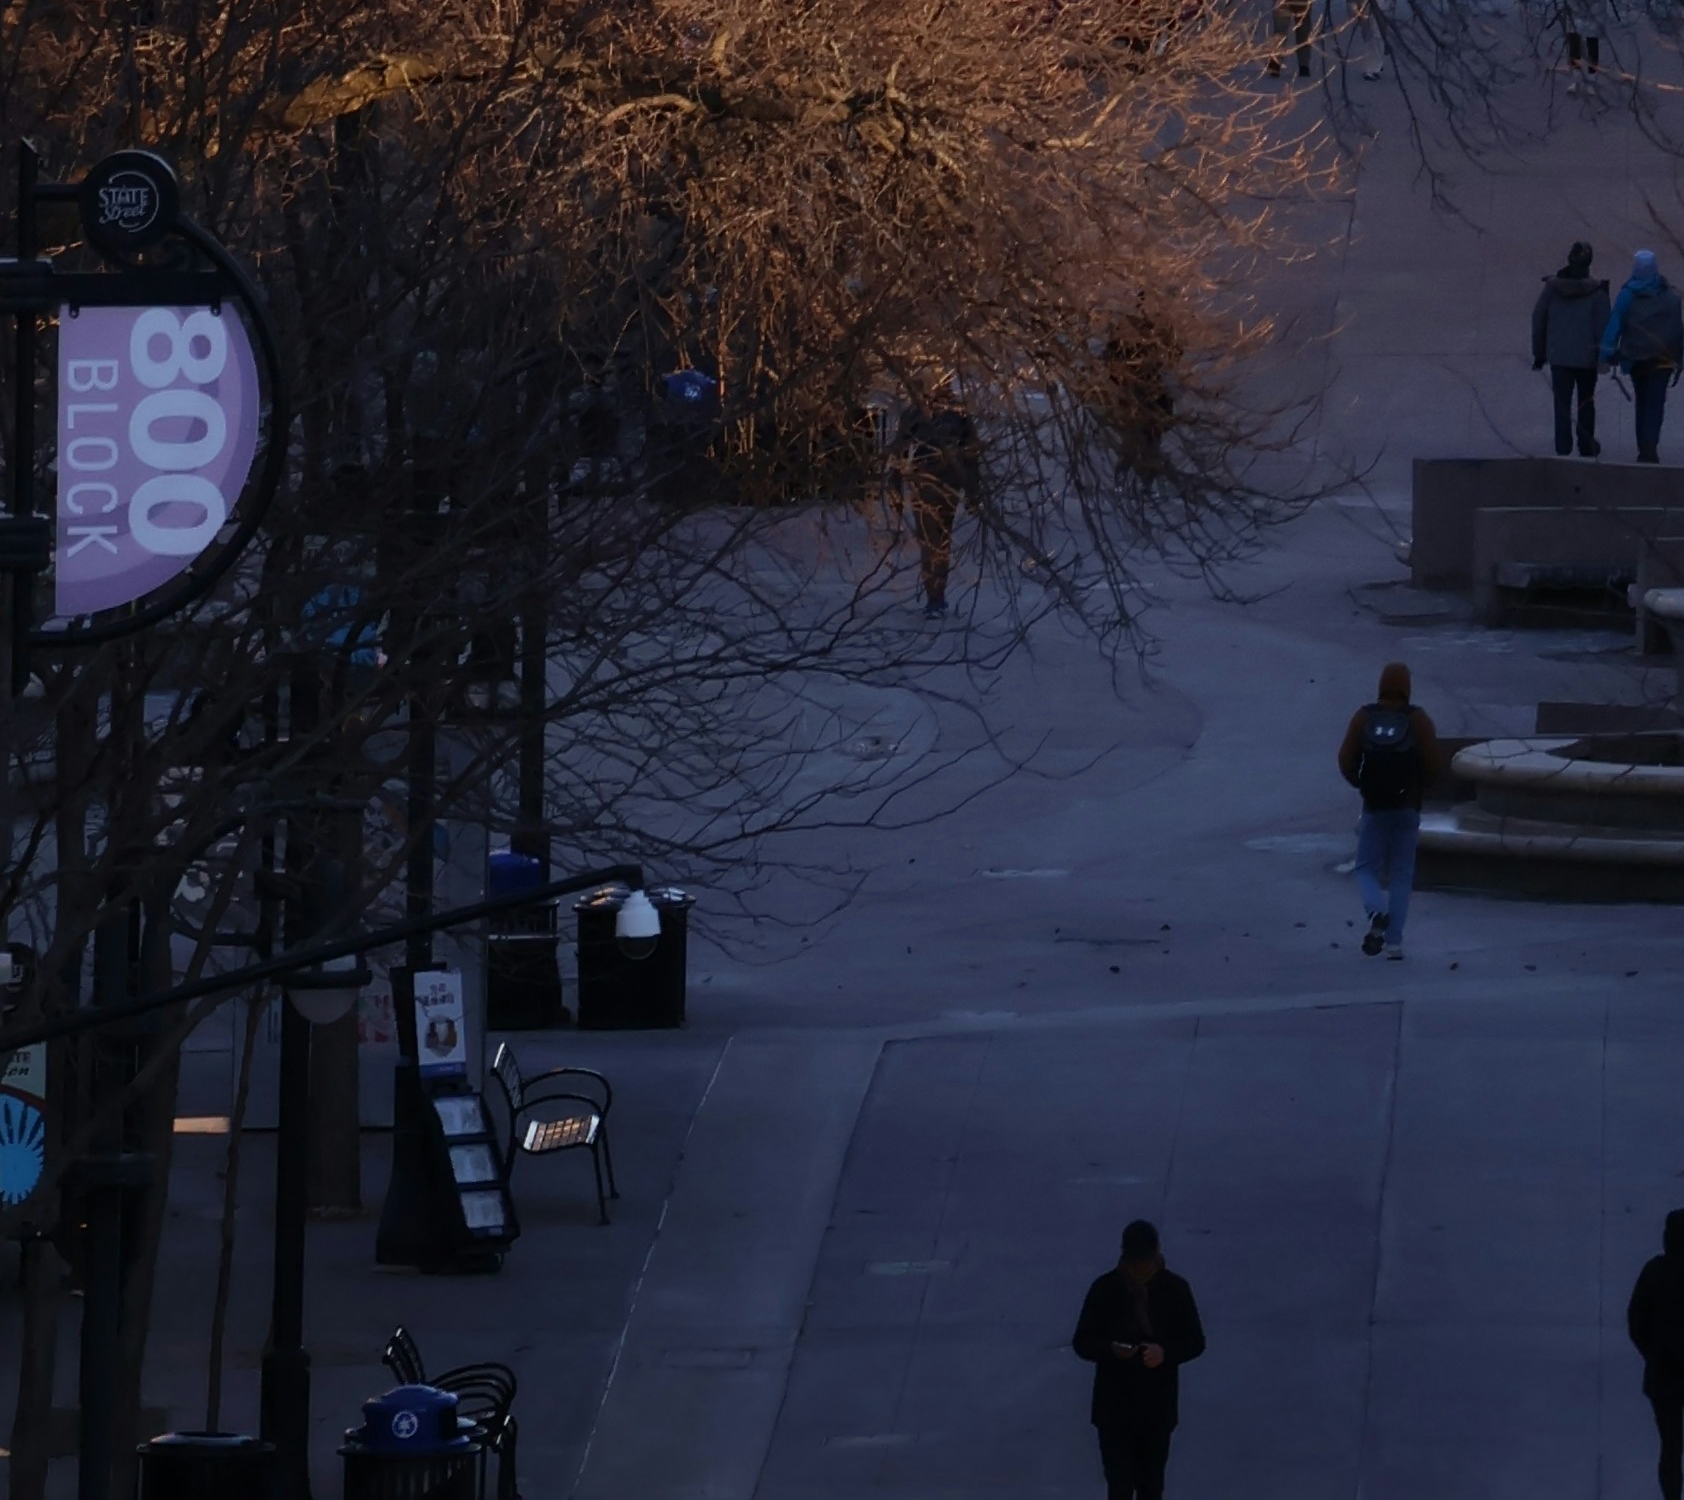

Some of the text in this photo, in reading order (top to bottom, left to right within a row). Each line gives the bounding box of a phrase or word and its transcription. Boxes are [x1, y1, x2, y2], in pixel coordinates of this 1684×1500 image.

[98, 204, 146, 225] Street
[99, 185, 150, 207] STATE
[66, 359, 119, 558] BLOCK
[129, 308, 227, 556] 800
